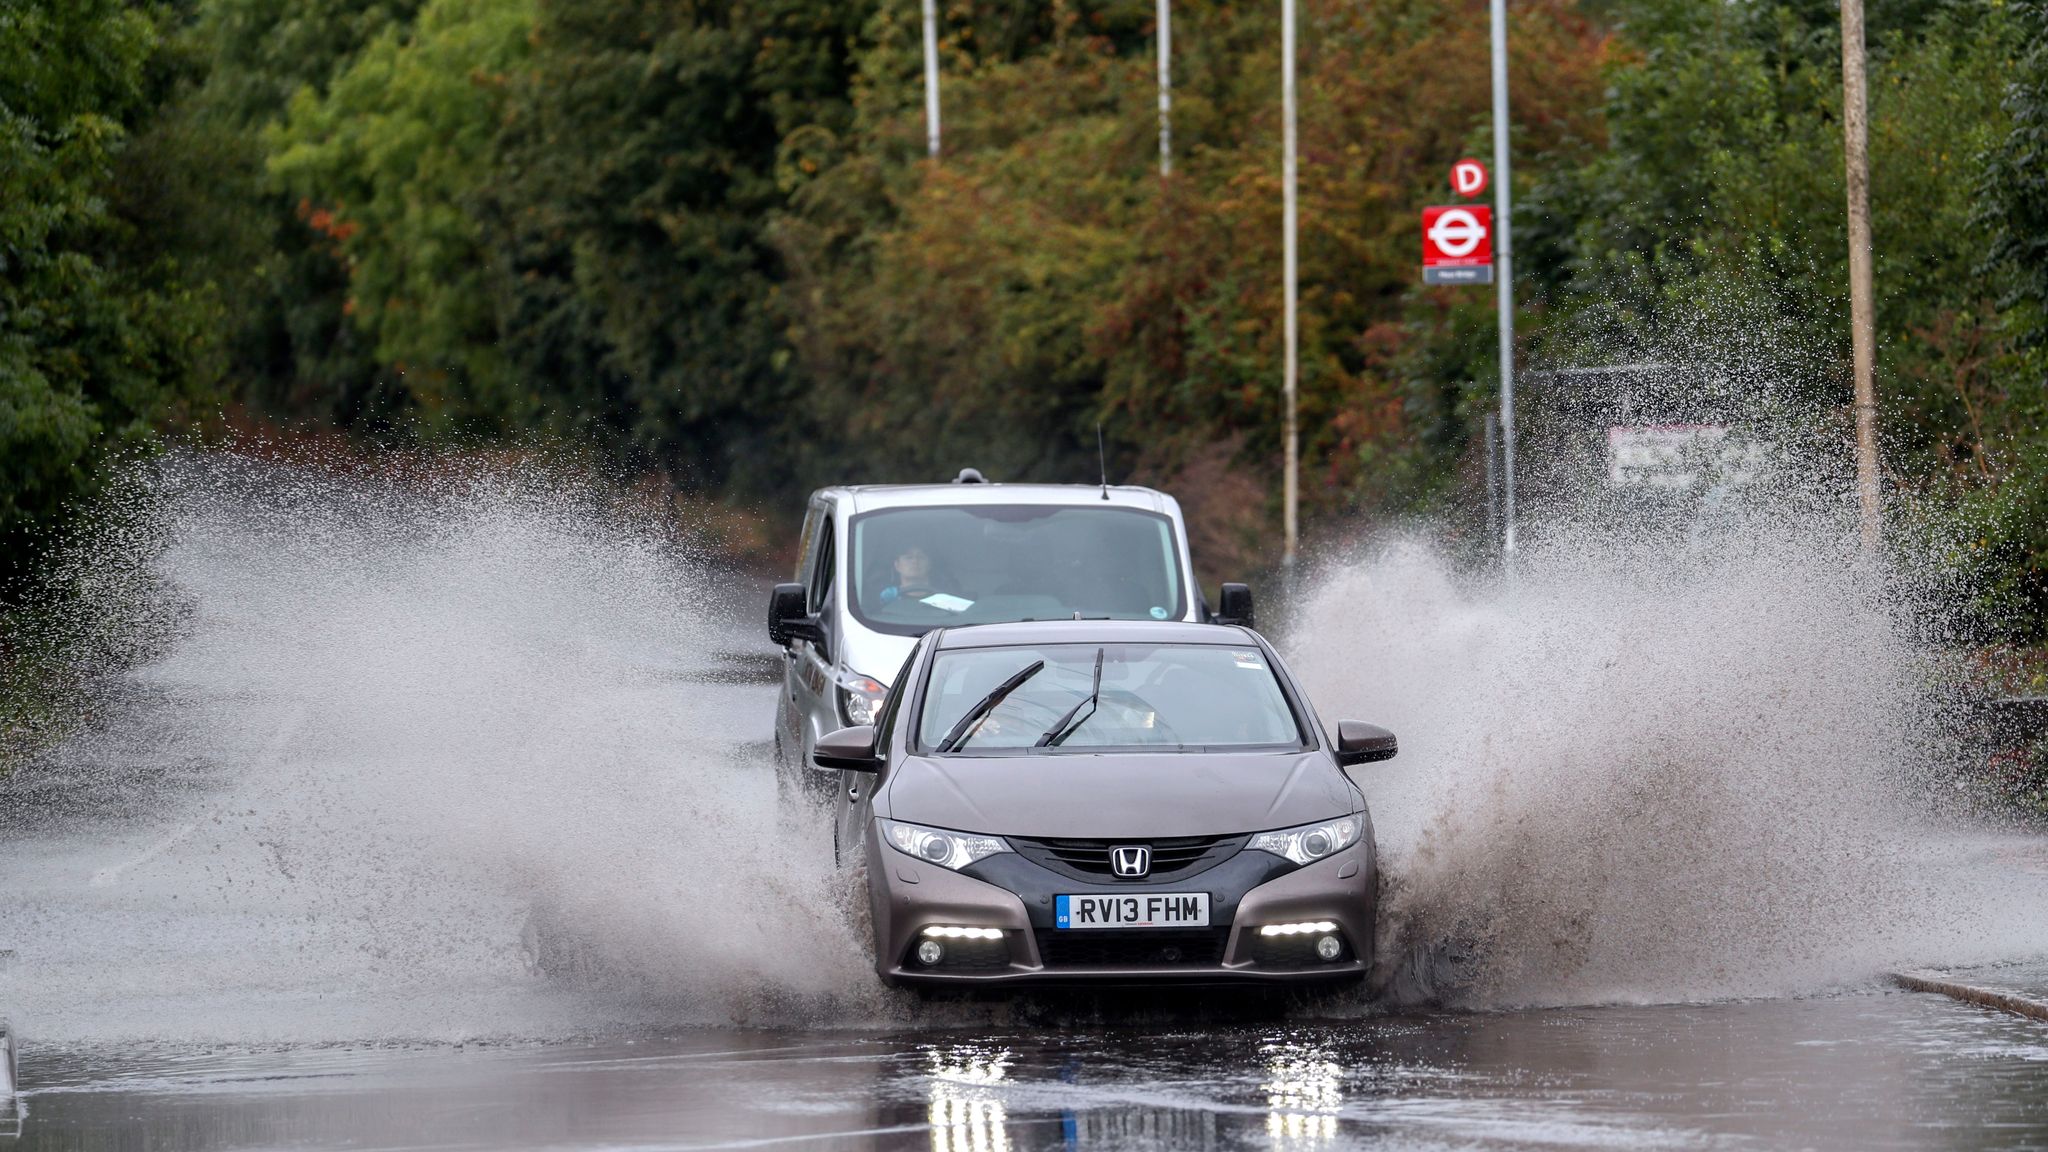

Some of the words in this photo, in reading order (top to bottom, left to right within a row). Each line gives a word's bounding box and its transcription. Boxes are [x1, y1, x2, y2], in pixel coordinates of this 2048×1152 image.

[1456, 163, 1483, 193] D
[1080, 898, 1139, 923] RV13
[1147, 897, 1198, 922] FHM
